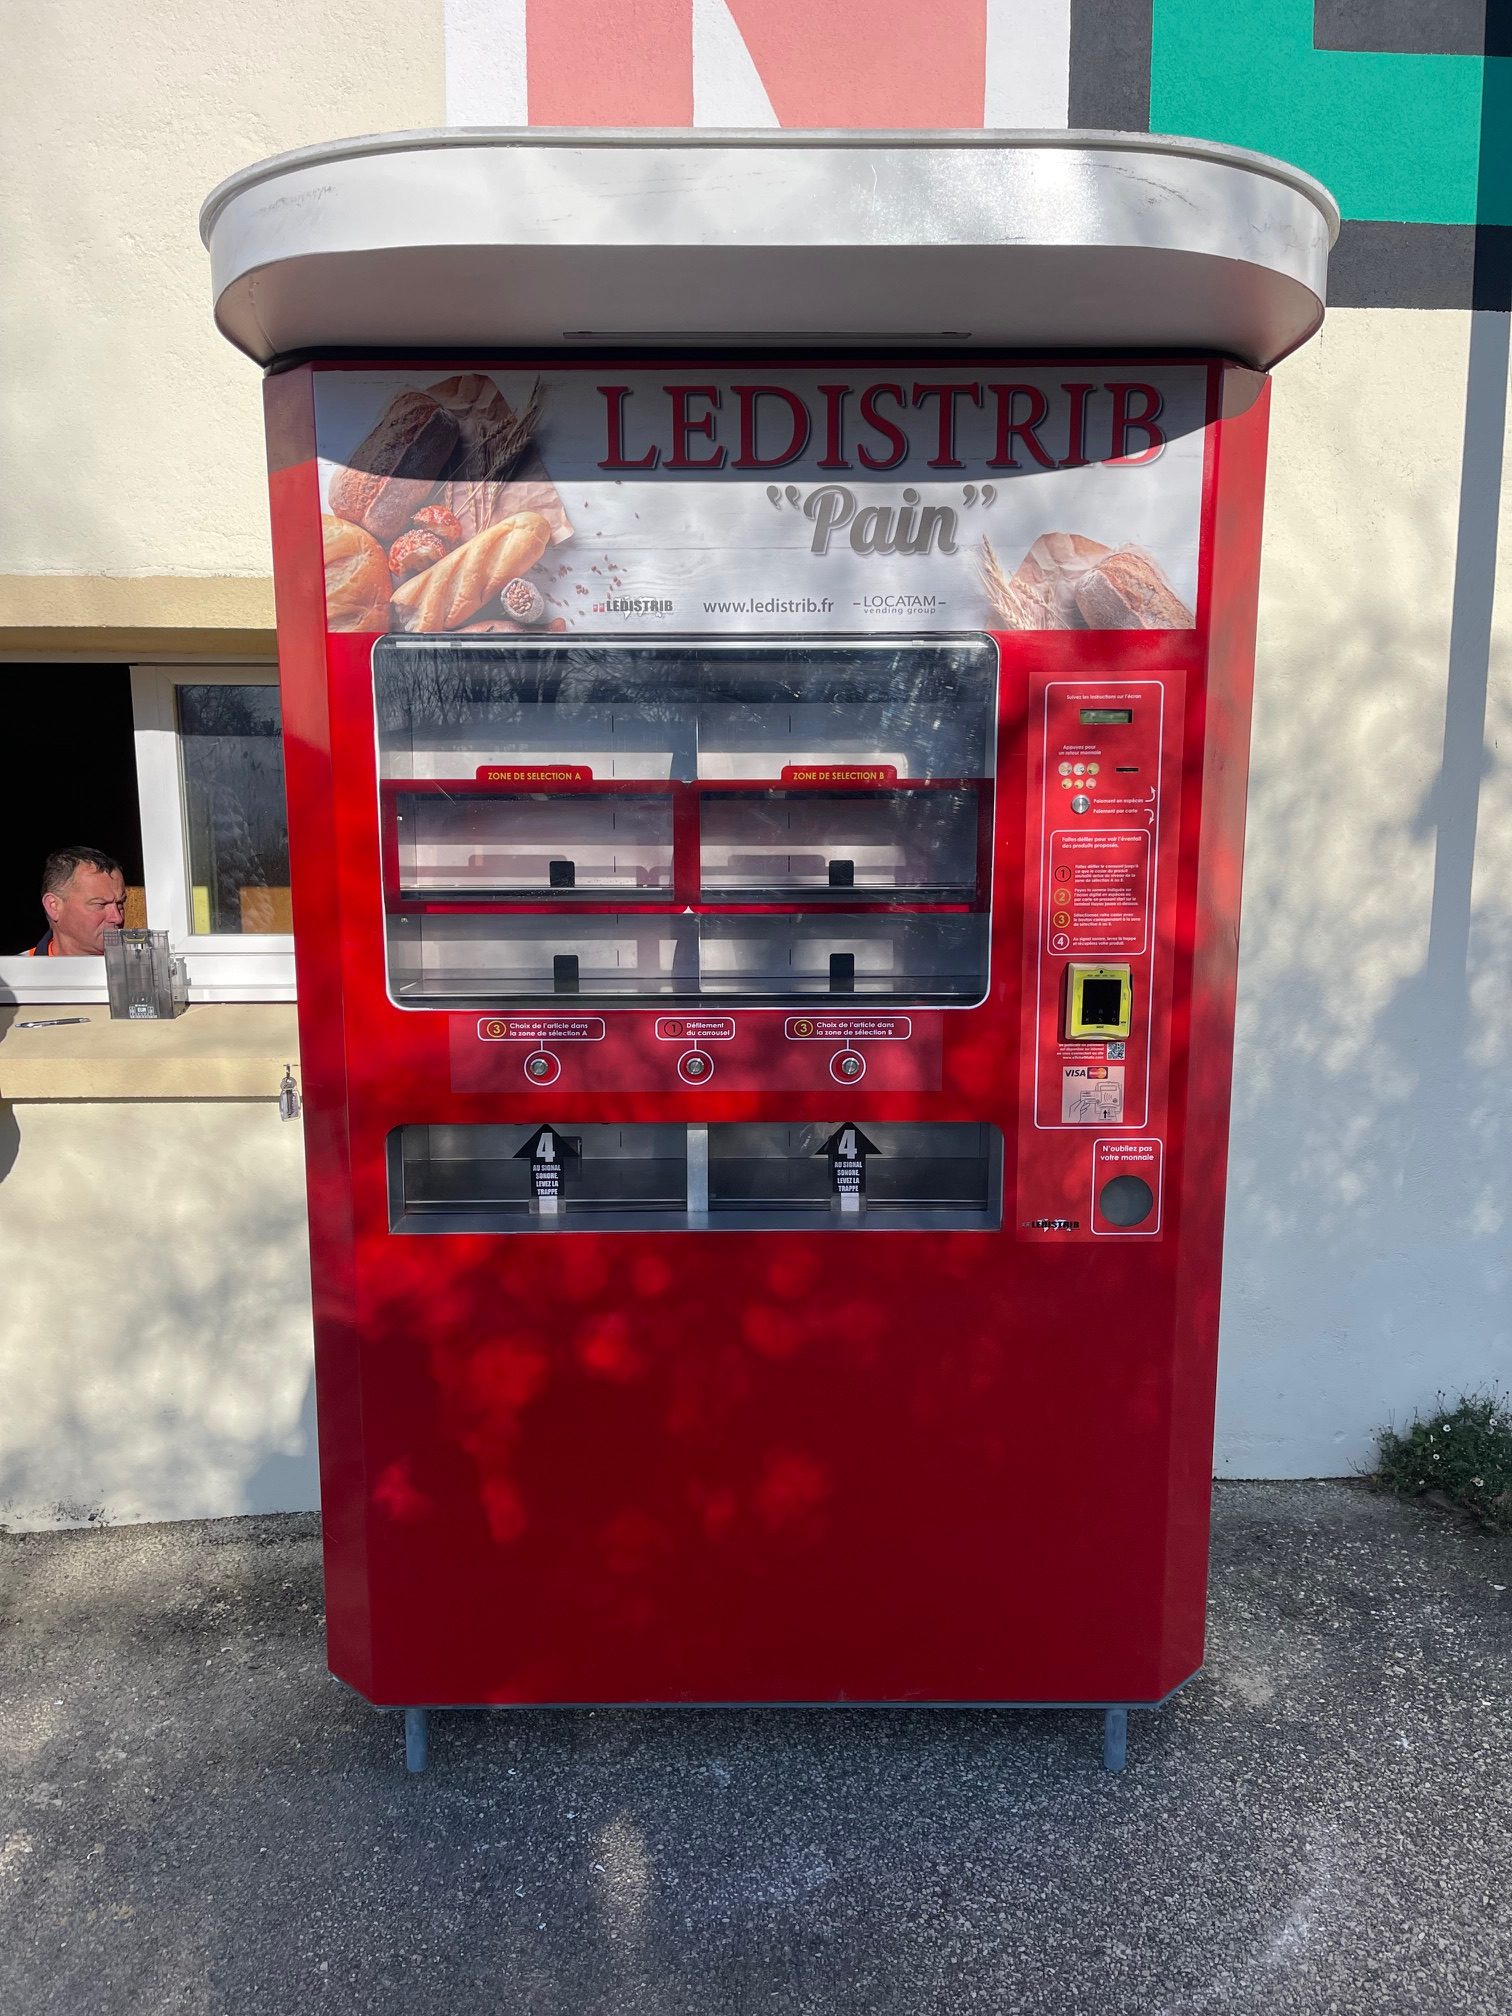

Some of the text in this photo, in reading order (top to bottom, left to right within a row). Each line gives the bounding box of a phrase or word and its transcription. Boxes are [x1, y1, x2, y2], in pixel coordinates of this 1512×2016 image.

[597, 382, 1165, 469] LEDISTRIB
[606, 599, 673, 612] LEDISTRIB
[703, 598, 834, 613] www.ledistrib.fr
[864, 607, 936, 615] vending group
[488, 772, 581, 780] ZONE DE SELECTION A
[793, 772, 884, 780] ZONE DE SELECTION B
[1059, 892, 1065, 901] 2
[1058, 915, 1065, 924] 3
[1057, 937, 1064, 946] 4
[493, 1025, 501, 1034] 3
[672, 1024, 676, 1033] 1
[800, 1024, 807, 1033] 3
[1065, 1069, 1086, 1077] VISA
[536, 1132, 555, 1162] 4
[838, 1129, 857, 1159] 4
